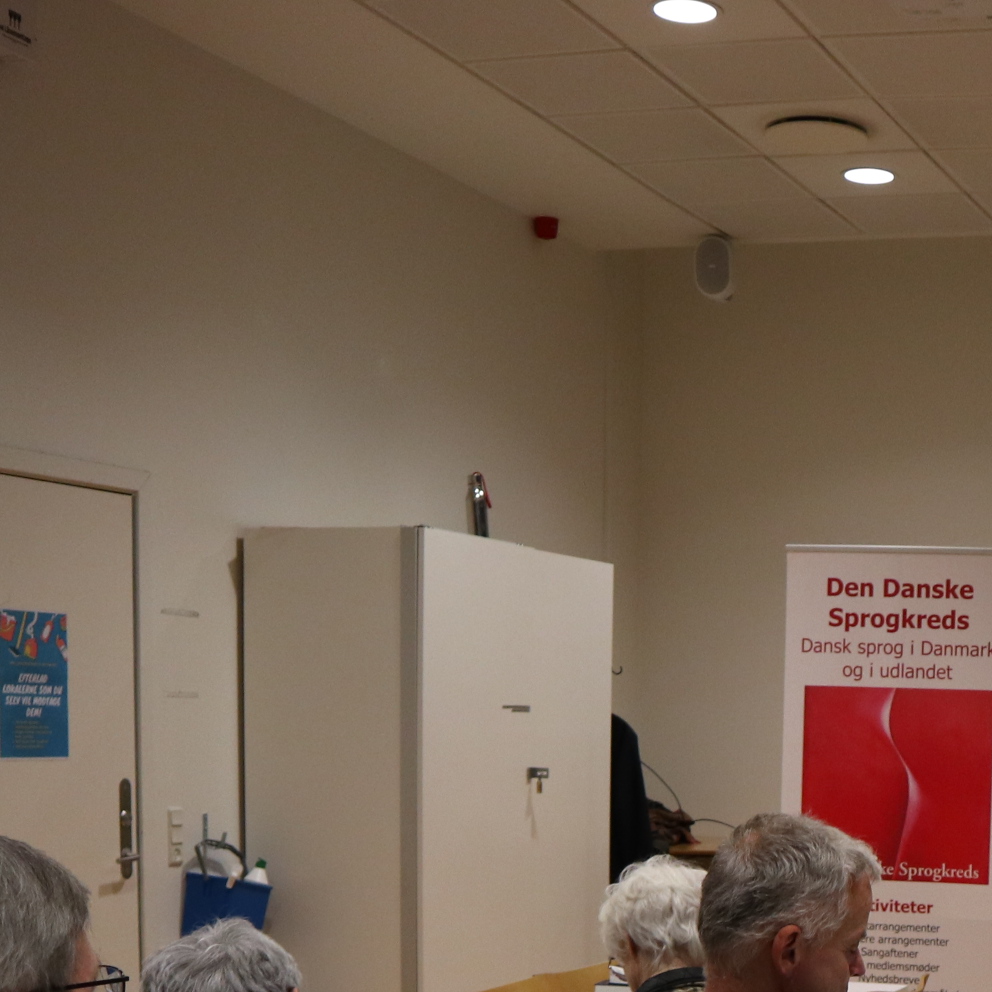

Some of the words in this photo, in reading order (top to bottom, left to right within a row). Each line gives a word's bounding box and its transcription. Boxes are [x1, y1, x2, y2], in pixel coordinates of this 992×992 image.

[826, 577, 874, 597] Den
[883, 578, 974, 599] Danske
[828, 607, 969, 633] Sprogkreds
[801, 638, 851, 654] Dansk
[857, 642, 904, 658] sprog
[910, 640, 914, 655] i
[842, 665, 863, 681] og
[869, 663, 873, 678] i
[880, 663, 953, 680] udlandet
[898, 861, 980, 882] Sprogkreds
[878, 936, 950, 948] arrangementer
[861, 947, 919, 959] Sangaftener
